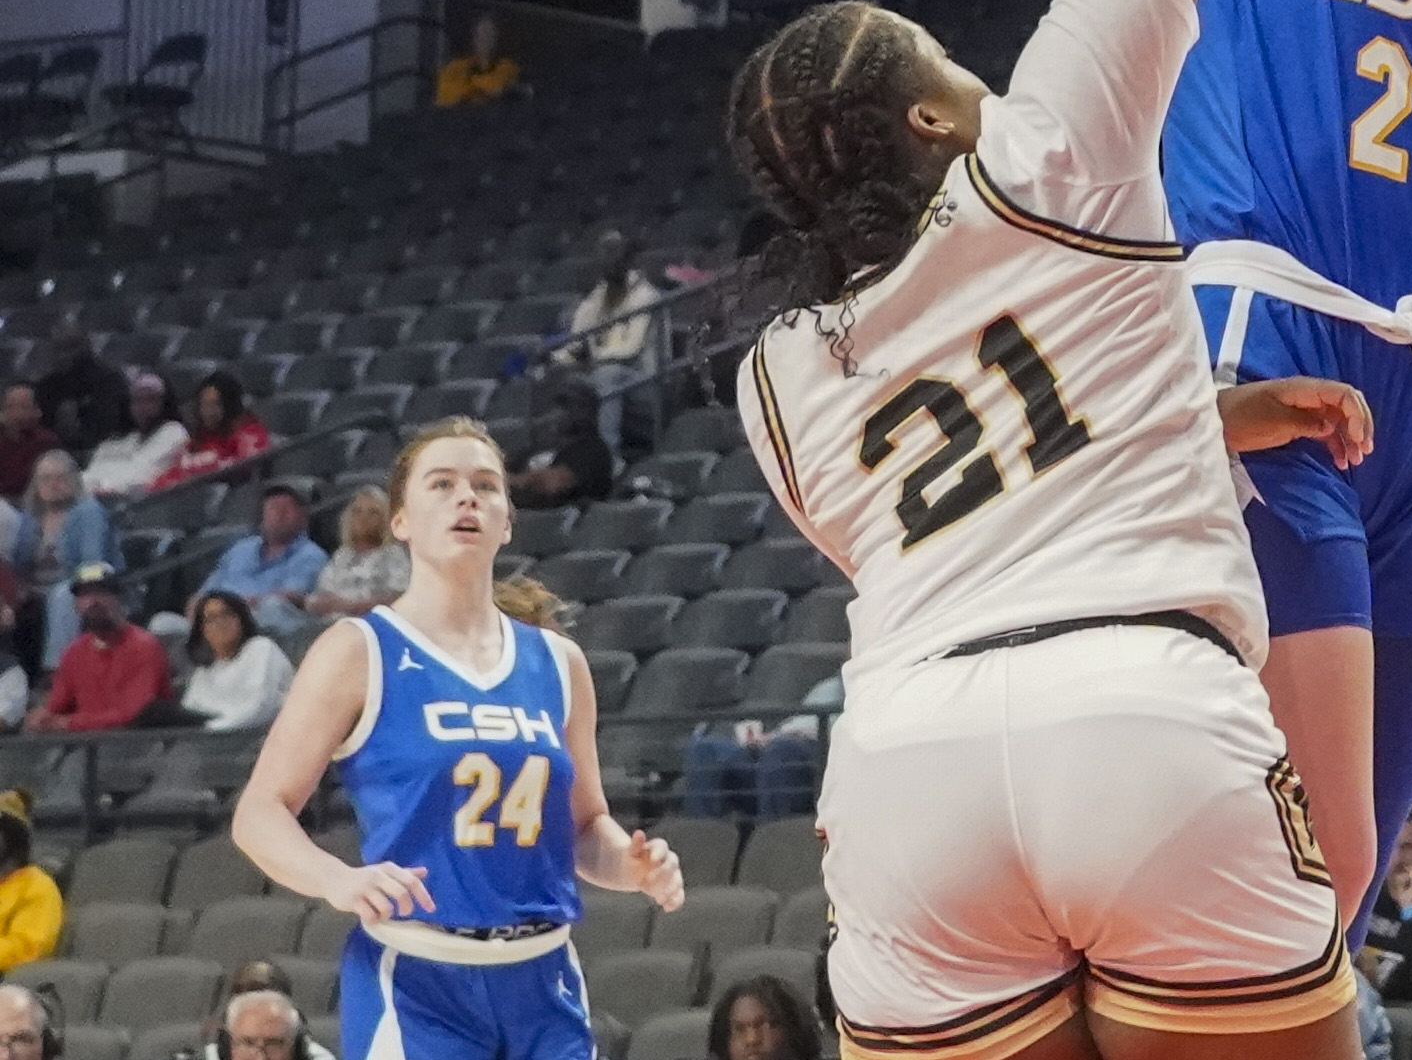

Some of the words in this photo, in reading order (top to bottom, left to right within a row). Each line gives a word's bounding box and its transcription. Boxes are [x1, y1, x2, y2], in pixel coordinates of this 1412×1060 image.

[857, 309, 1094, 555] 21
[423, 701, 561, 749] CSH
[453, 751, 550, 847] 24
